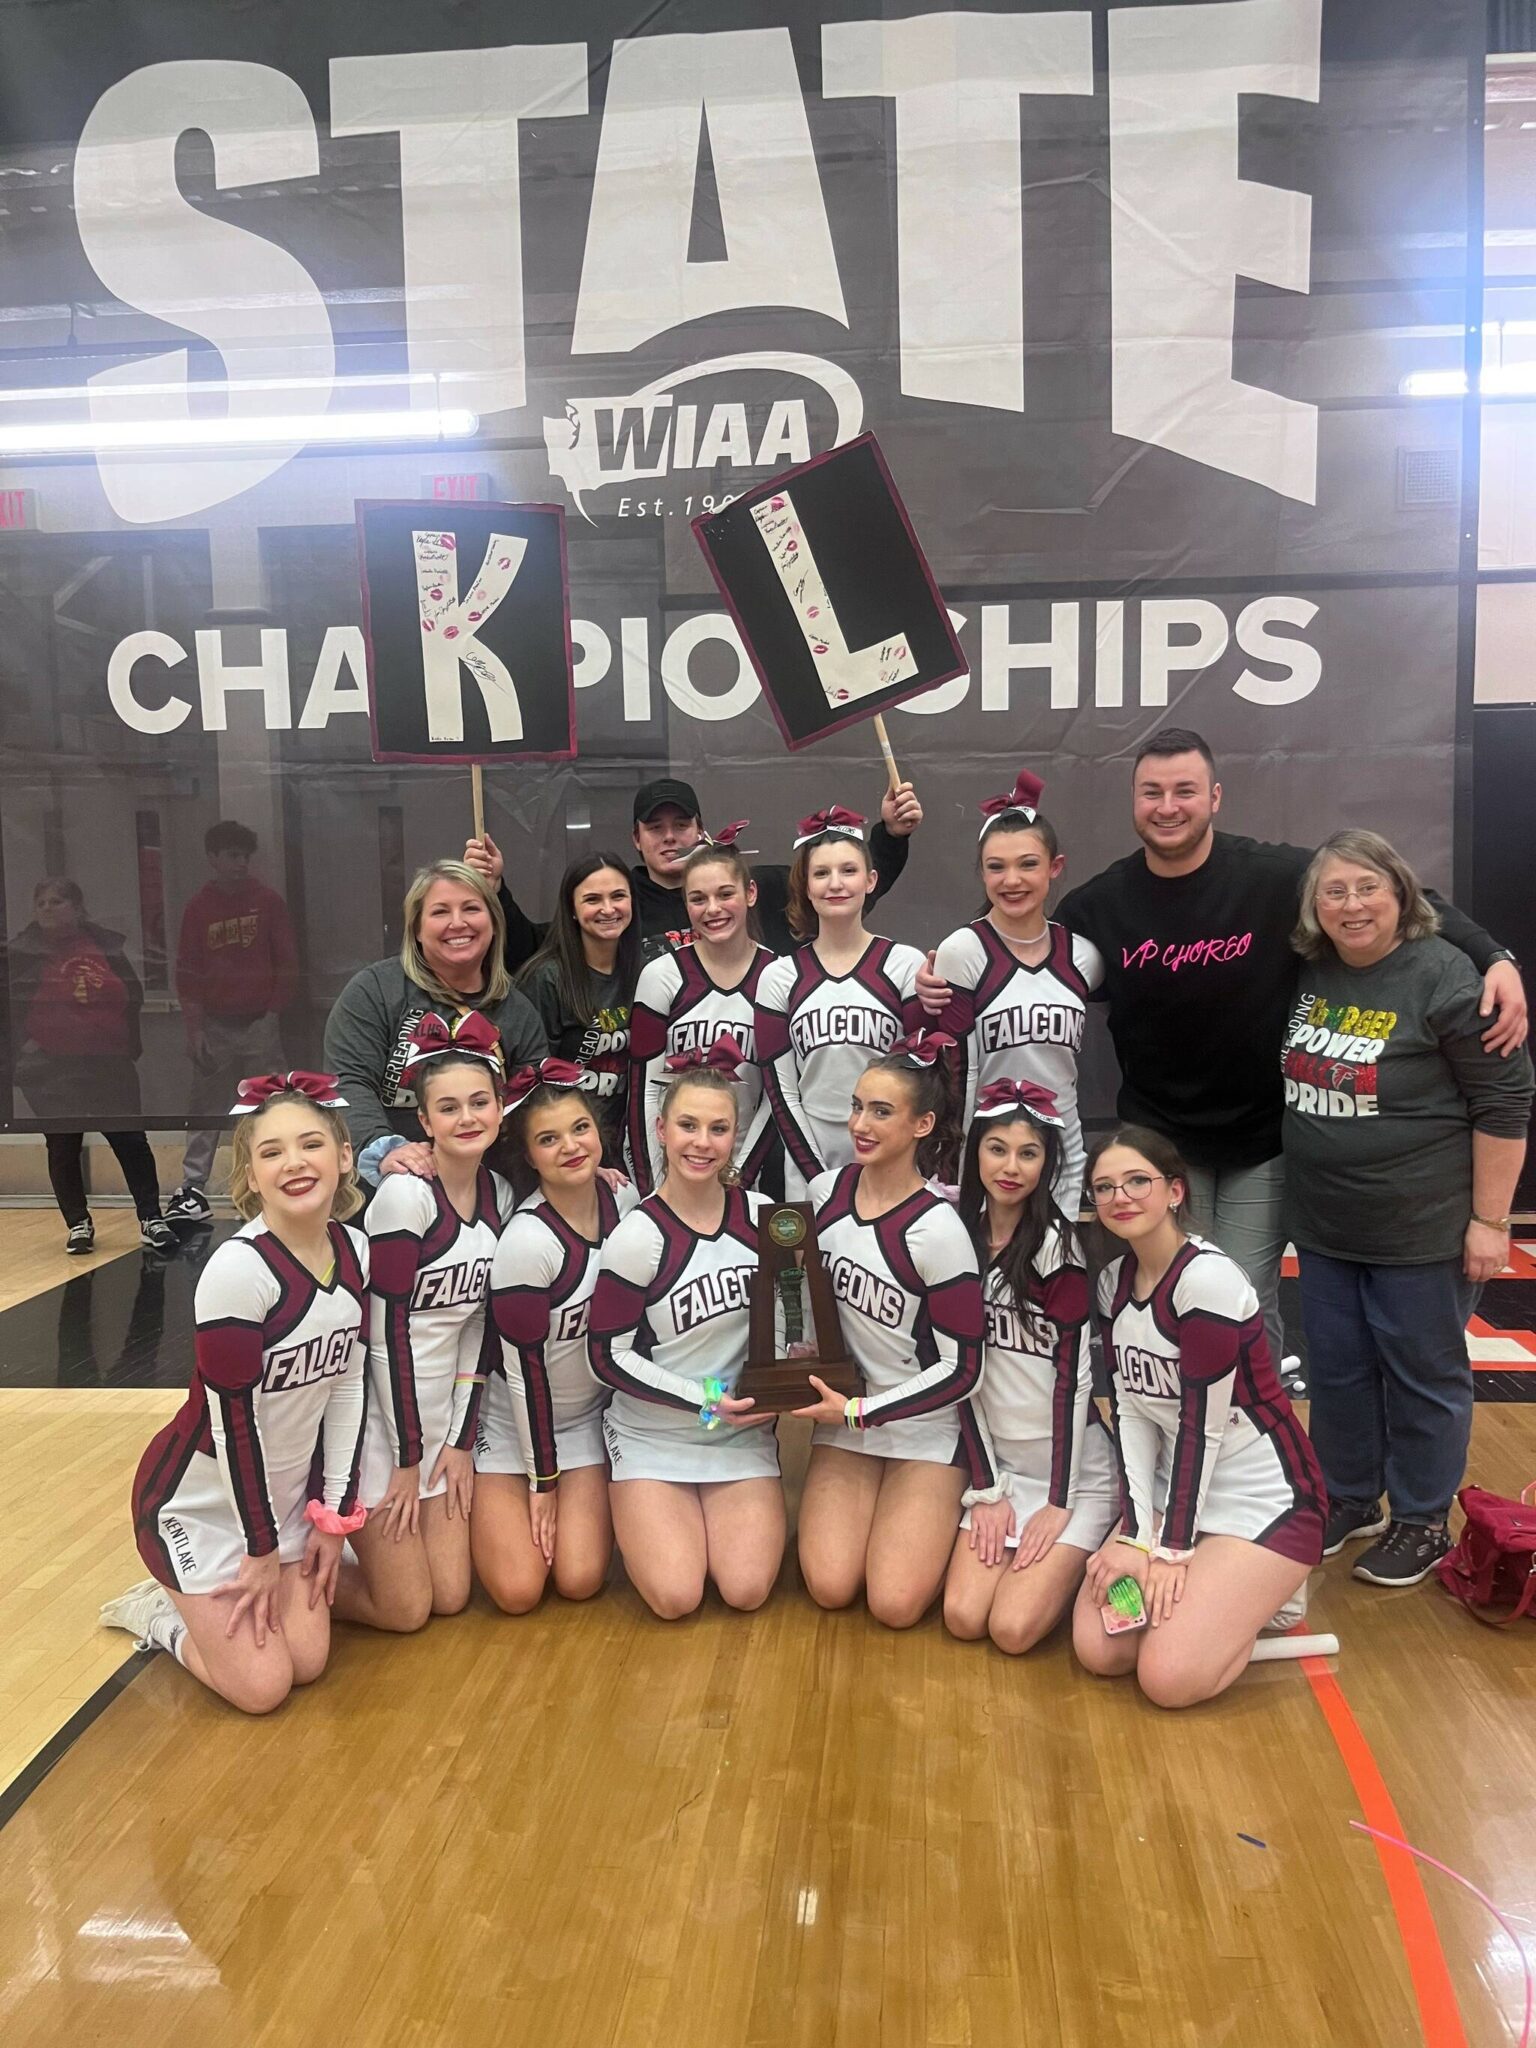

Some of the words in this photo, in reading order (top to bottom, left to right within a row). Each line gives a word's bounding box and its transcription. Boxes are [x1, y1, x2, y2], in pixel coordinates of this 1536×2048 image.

[73, 0, 1322, 525] STATE
[594, 398, 812, 472] WIAA
[750, 490, 919, 709] L
[107, 596, 1322, 735] CHAIOHIPS
[412, 531, 528, 742] K
[1122, 939, 1159, 968] VP
[1162, 932, 1252, 972] CHOREO
[380, 1008, 425, 1108] CHEERLEADING
[791, 1006, 897, 1060] FALCONS
[983, 1004, 1085, 1053] FALCONS
[1290, 1024, 1386, 1064] POWER
[1284, 1078, 1379, 1117] PRIDE
[670, 1265, 759, 1335] FALCO
[162, 1516, 197, 1576] KENTLAKE
